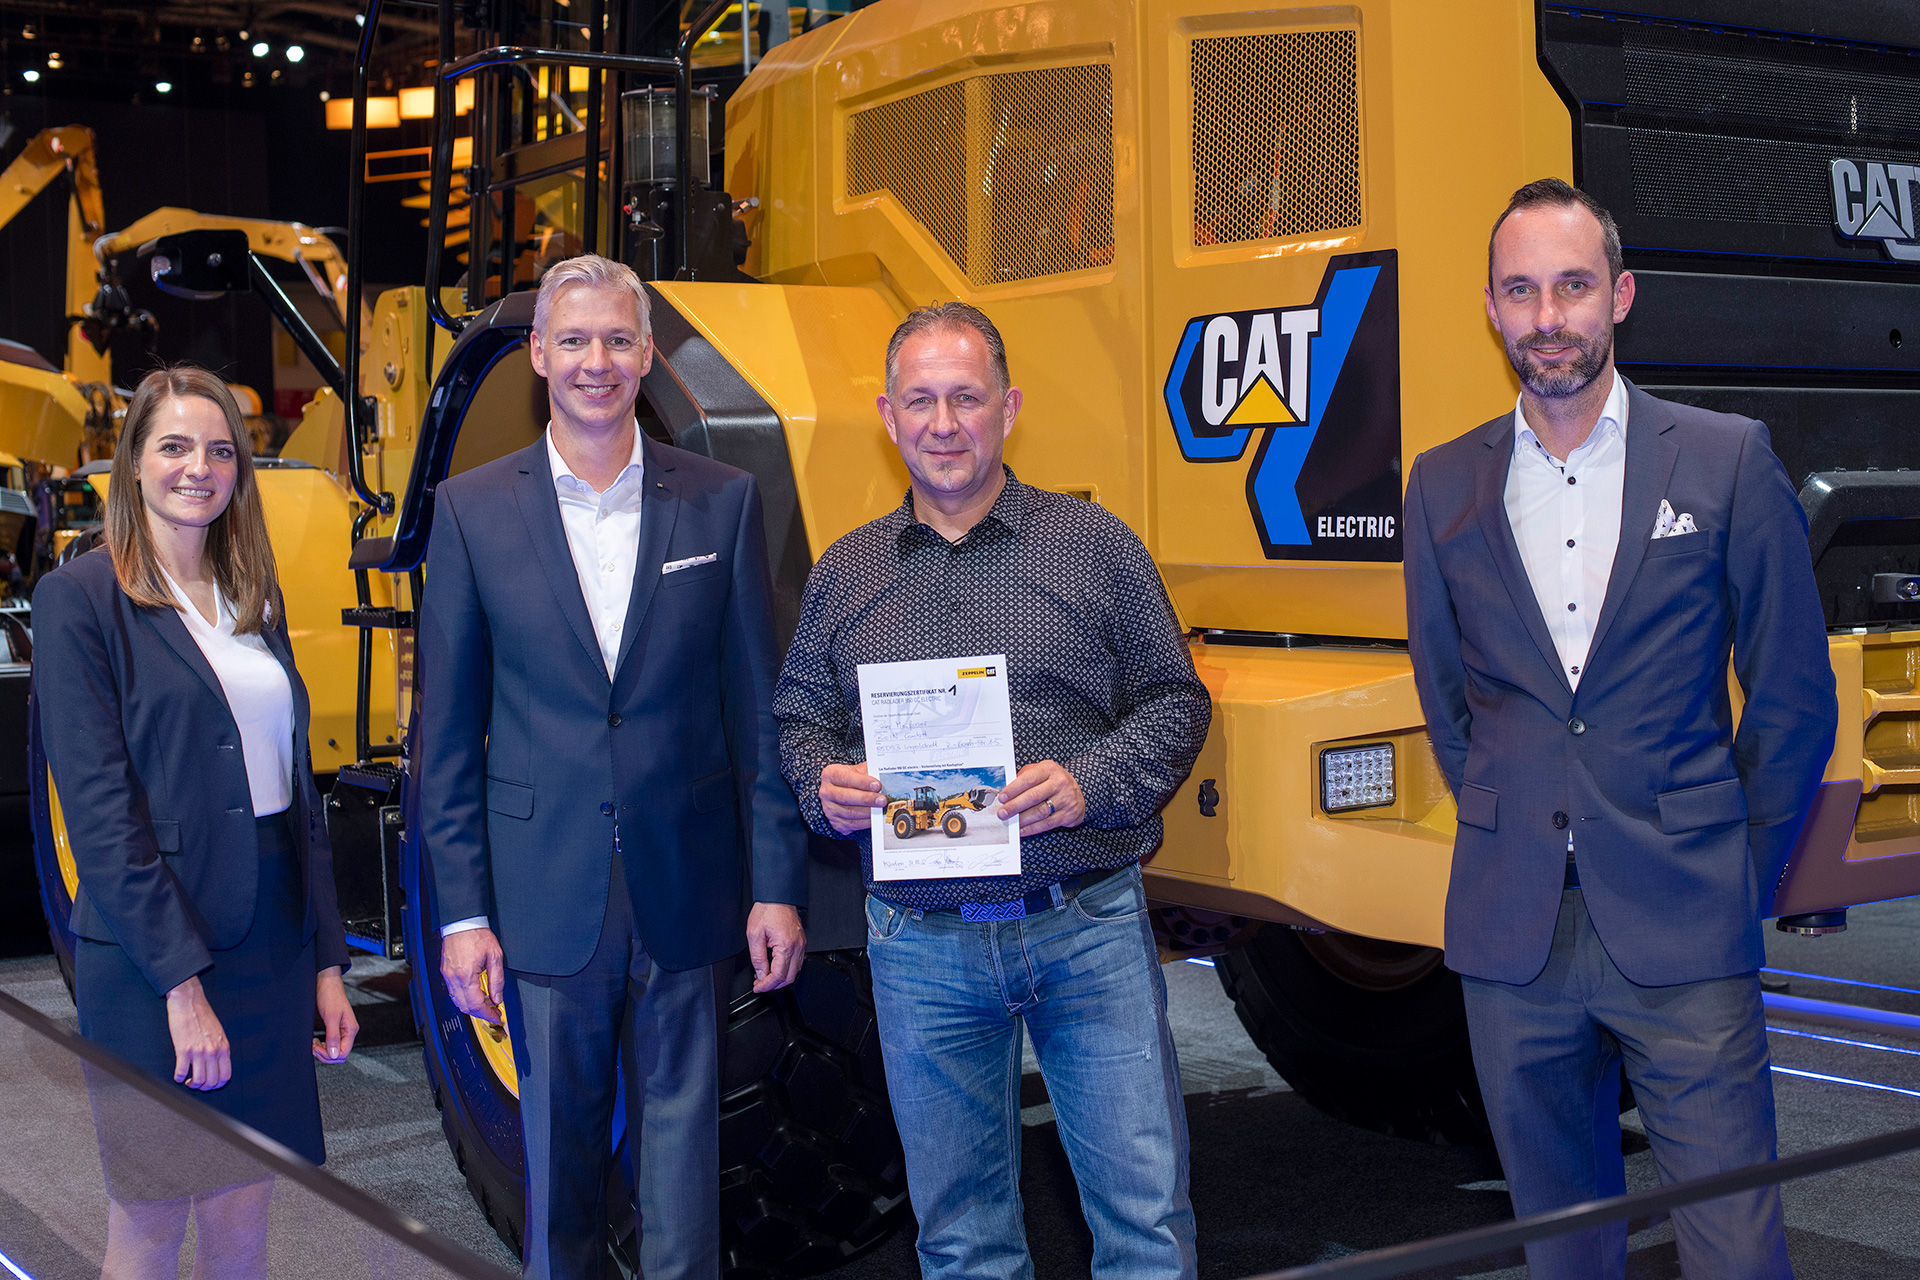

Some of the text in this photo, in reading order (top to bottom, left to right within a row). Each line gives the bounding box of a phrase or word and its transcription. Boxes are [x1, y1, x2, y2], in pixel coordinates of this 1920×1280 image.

[1832, 159, 1915, 239] CAT
[1201, 308, 1319, 426] CAT
[1317, 515, 1395, 539] ELECTRIC
[870, 688, 937, 698] RESERVIERUNGSZERTIFIKAT
[948, 684, 957, 696] 1
[871, 698, 880, 706] CAT
